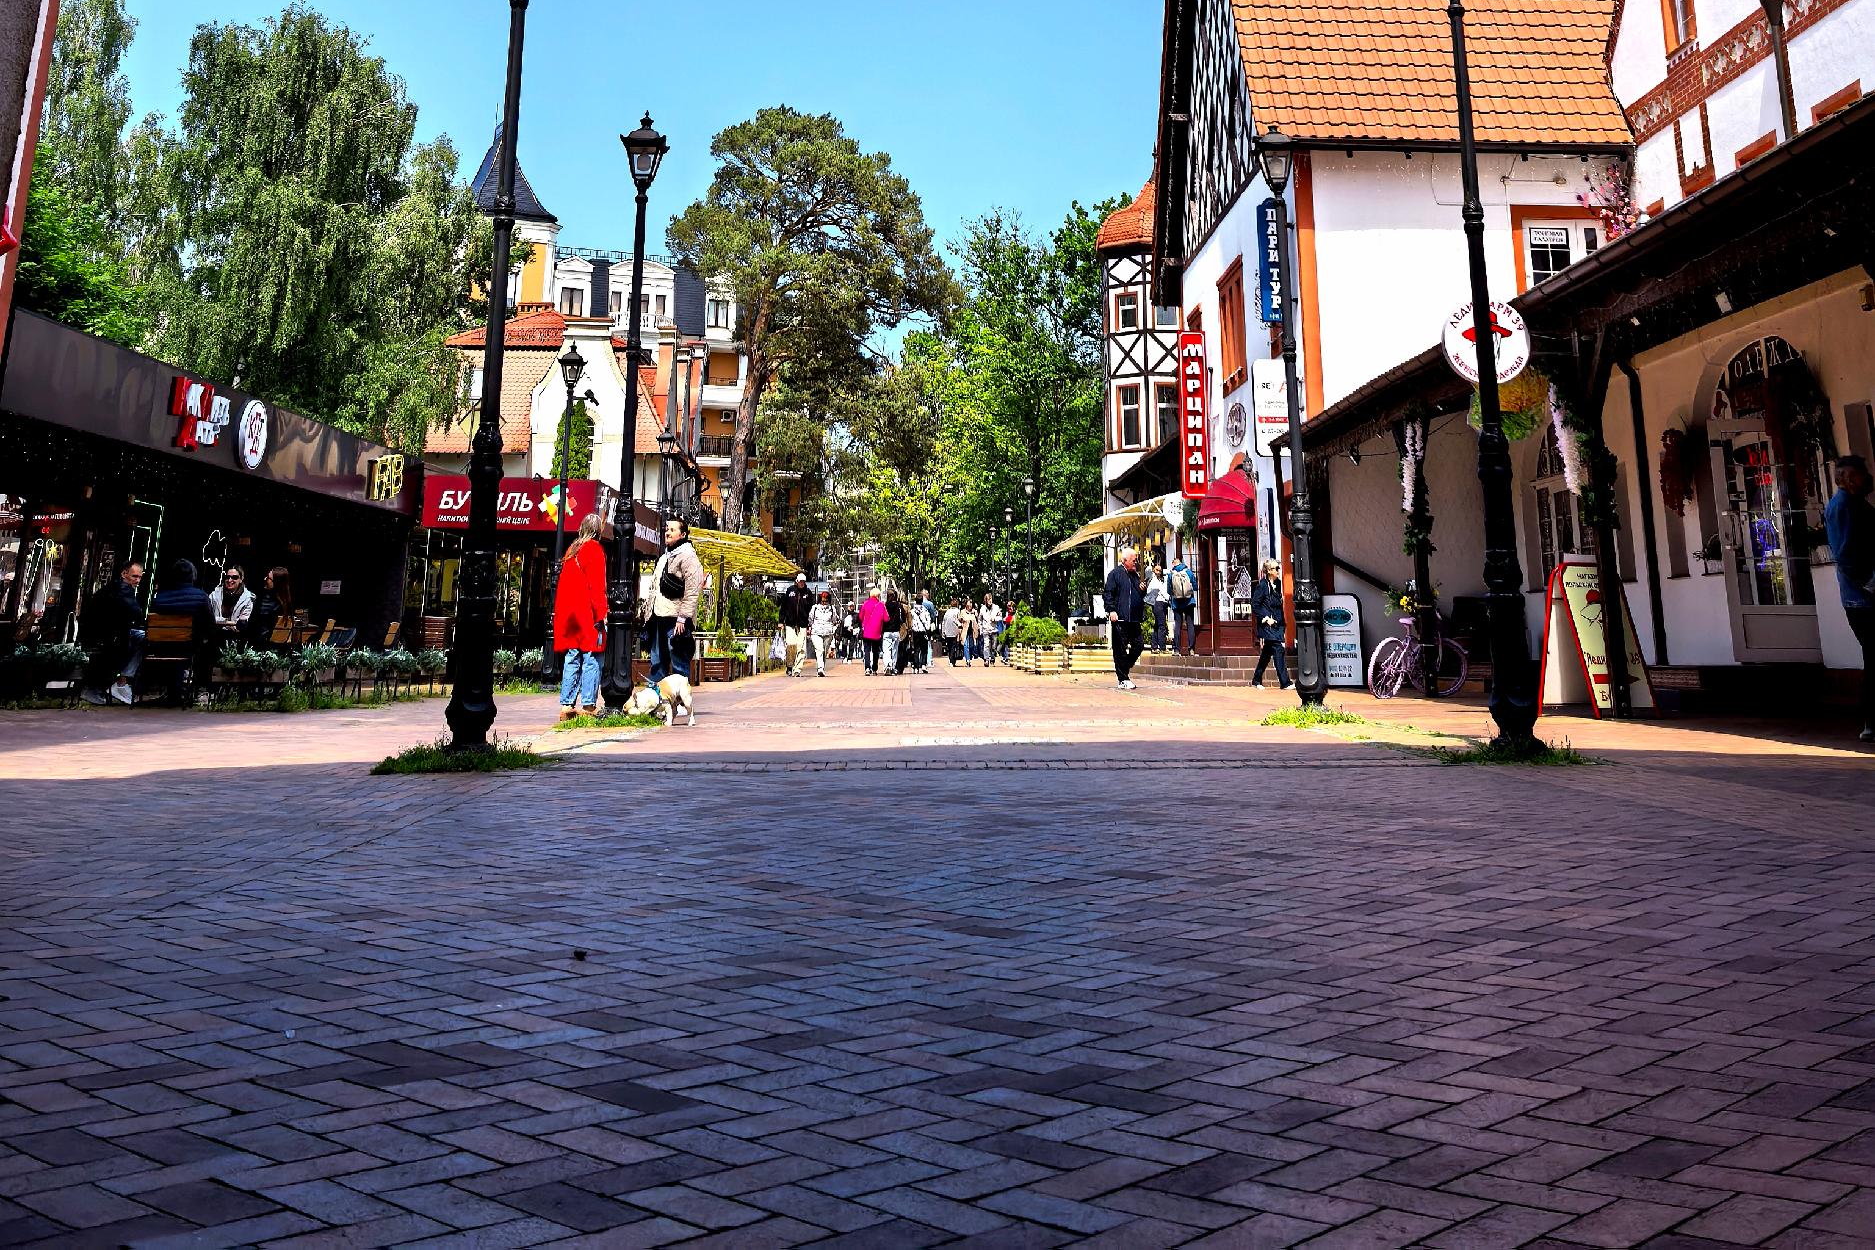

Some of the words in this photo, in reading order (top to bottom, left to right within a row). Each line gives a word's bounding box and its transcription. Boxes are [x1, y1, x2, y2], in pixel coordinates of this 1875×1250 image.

[1265, 208, 1280, 263] ПАРИ
[1269, 267, 1282, 310] ТУР
[1182, 343, 1205, 484] МАРЦИПАН
[438, 490, 533, 512] БУЛЬ
